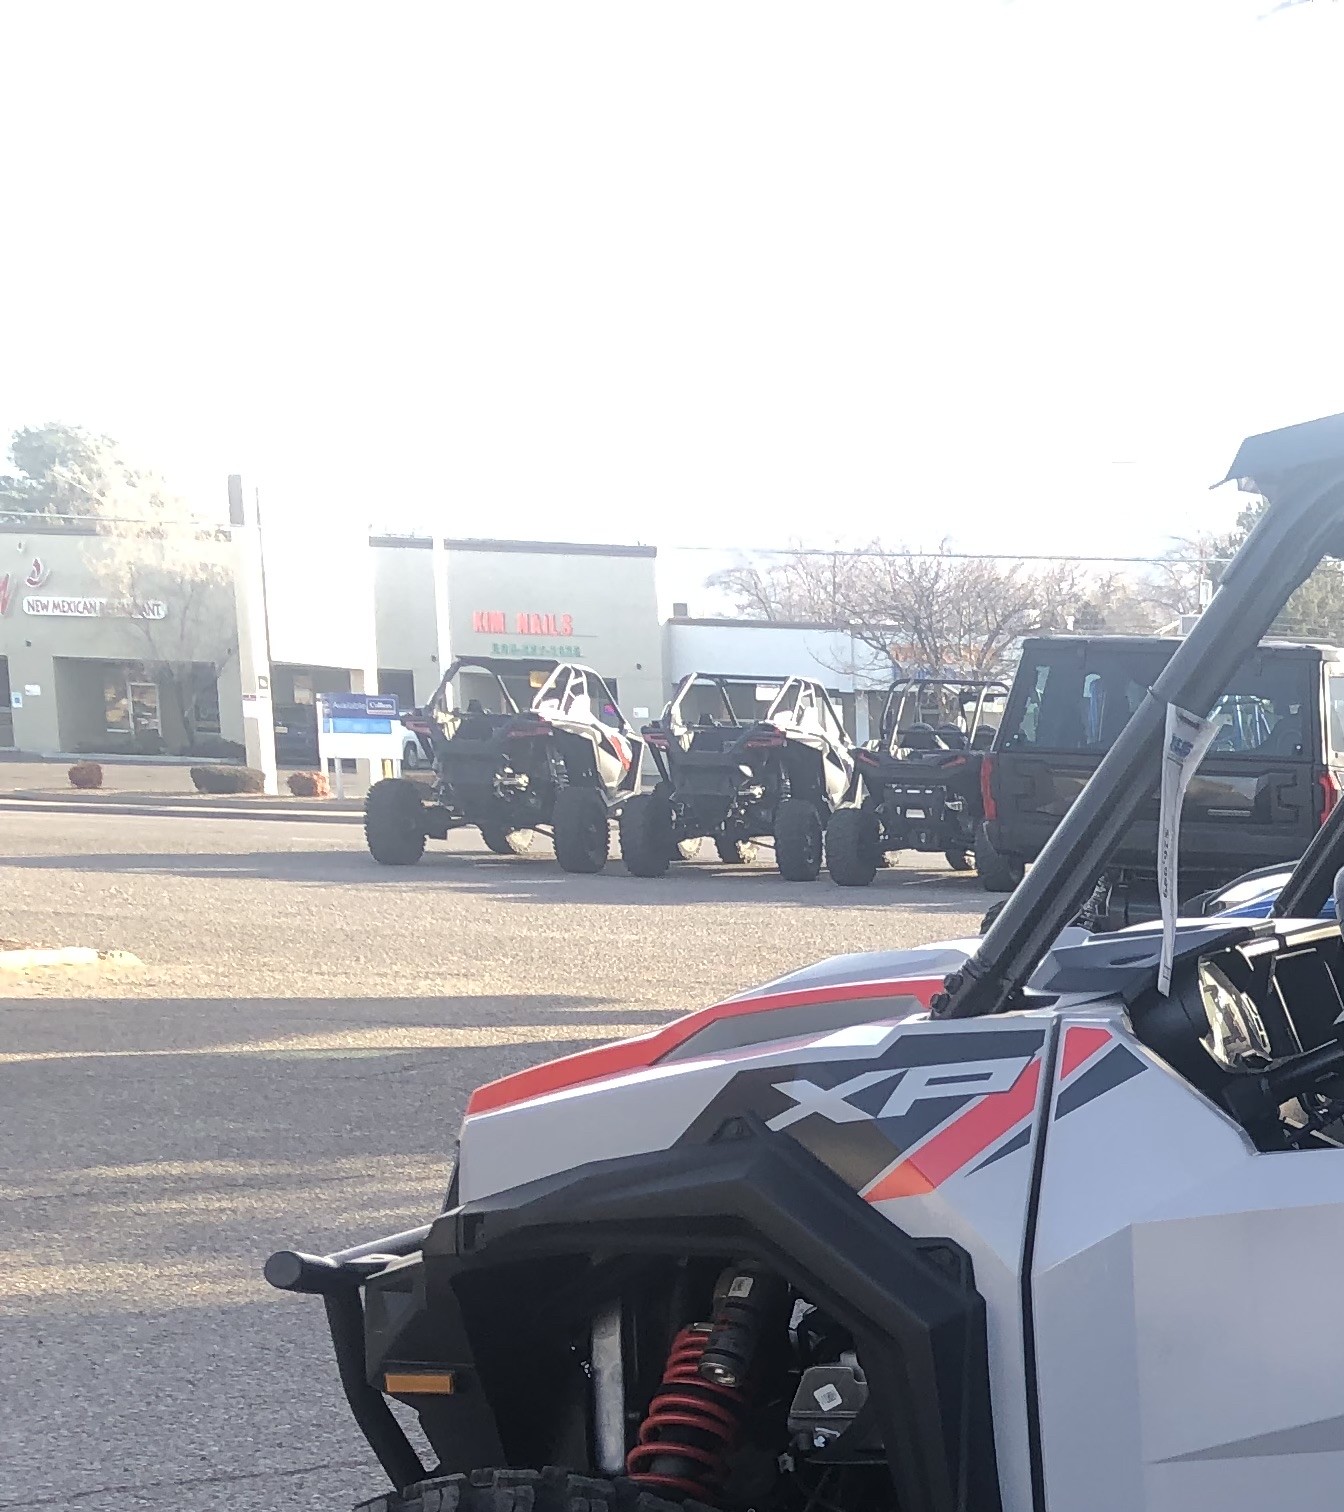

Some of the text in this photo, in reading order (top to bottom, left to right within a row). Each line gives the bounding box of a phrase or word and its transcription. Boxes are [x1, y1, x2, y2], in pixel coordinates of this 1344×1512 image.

[27, 600, 49, 613] NEW
[52, 600, 98, 614] MEXICAN
[473, 611, 573, 636] KIM NAILS
[765, 1056, 1032, 1132] XP
